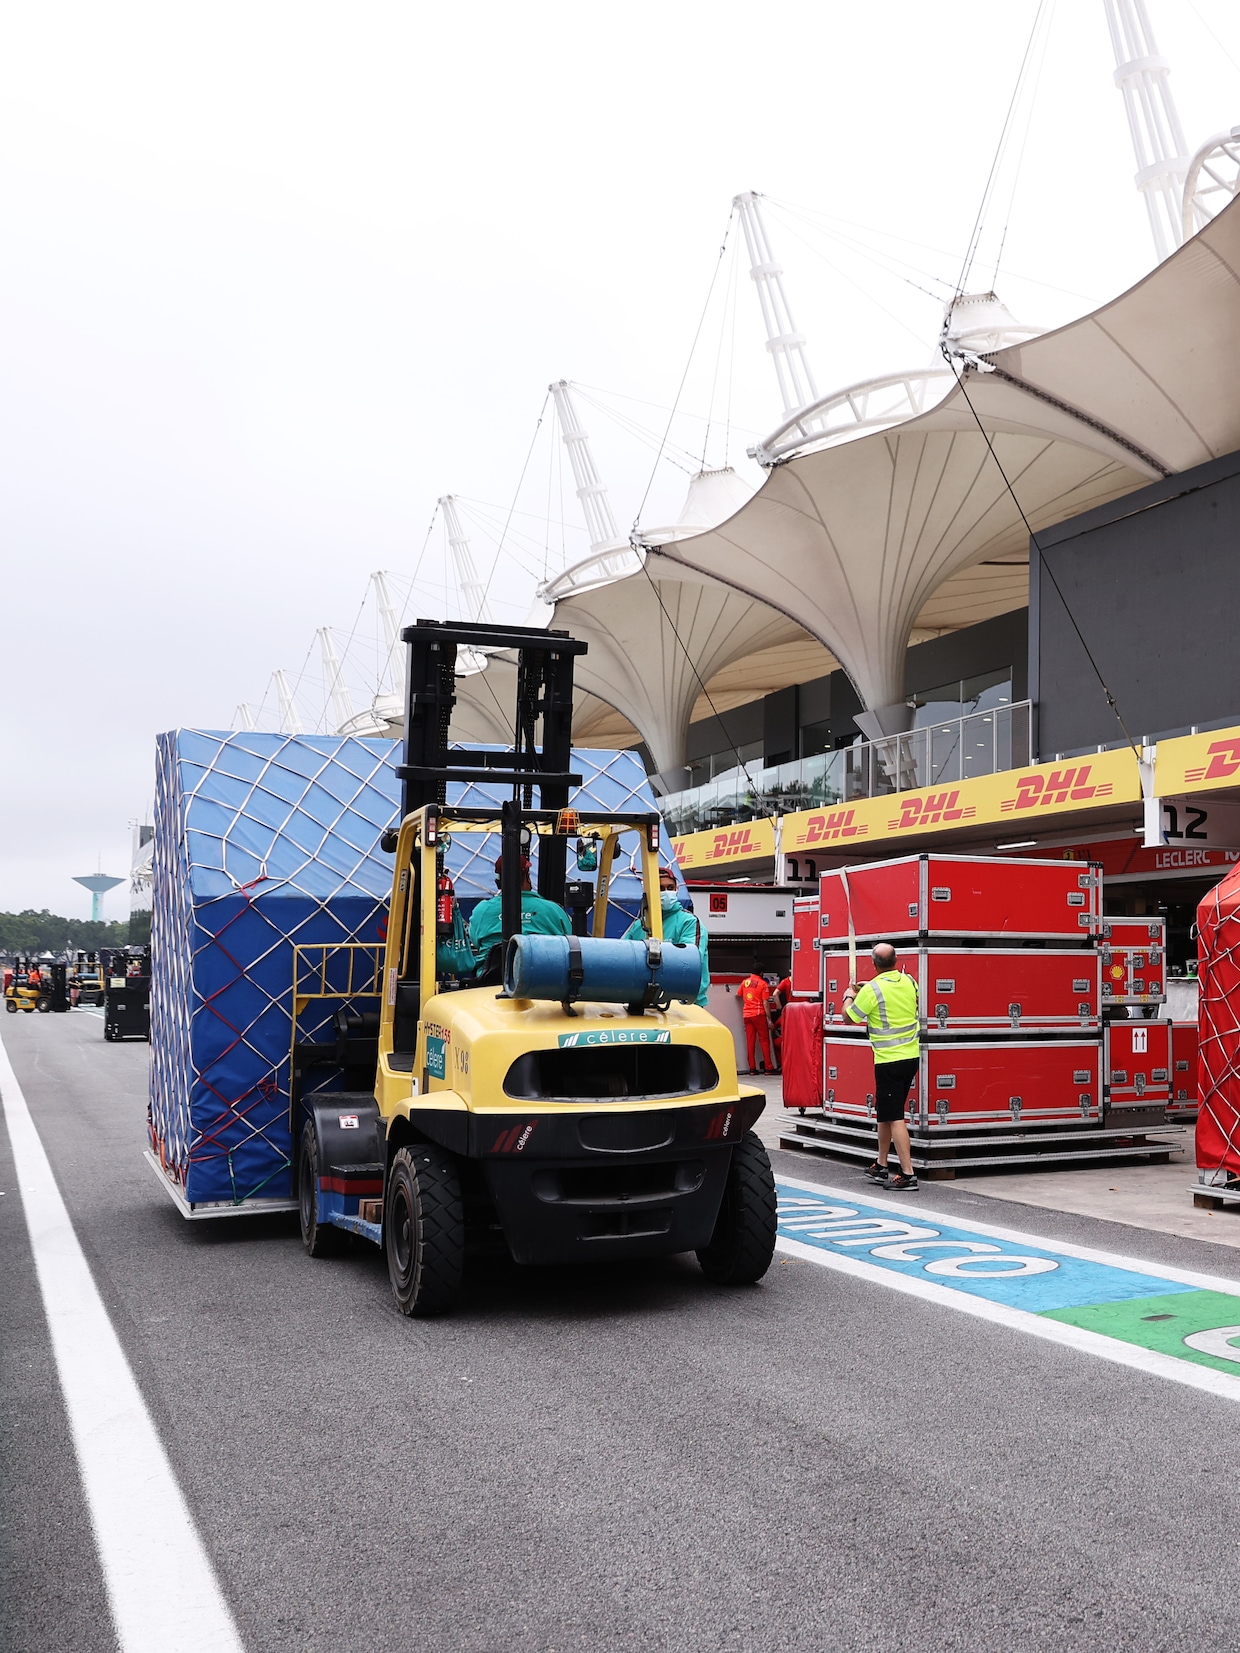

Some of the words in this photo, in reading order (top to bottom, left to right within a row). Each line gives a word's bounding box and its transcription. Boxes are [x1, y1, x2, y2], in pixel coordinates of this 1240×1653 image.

[1015, 765, 1098, 810] DHL
[899, 791, 962, 829] DHL
[1163, 805, 1208, 839] 12
[806, 810, 859, 843] DHL
[713, 829, 753, 859] DHL
[787, 858, 820, 882] 11
[1156, 850, 1211, 868] LECLERC
[713, 897, 726, 910] 05
[424, 1021, 441, 1038] HYSTER
[441, 1028, 451, 1045] 155
[587, 1030, 648, 1044] célere
